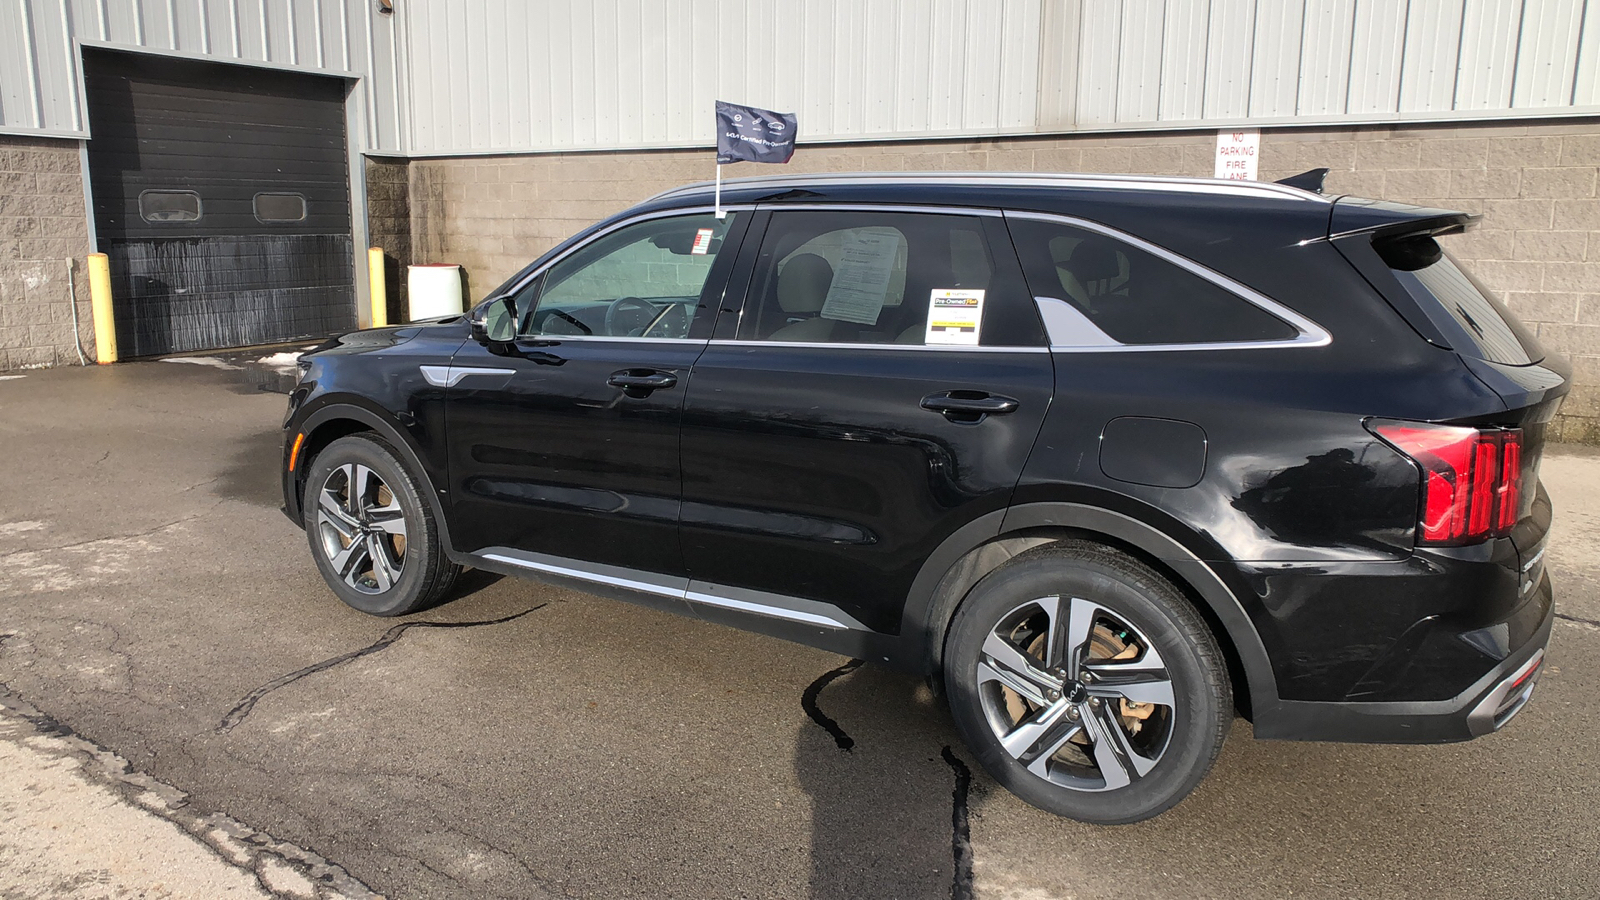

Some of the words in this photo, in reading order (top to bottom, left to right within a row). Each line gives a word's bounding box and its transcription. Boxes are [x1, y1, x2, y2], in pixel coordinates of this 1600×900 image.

[740, 135, 762, 145] Certified
[1232, 132, 1244, 142] NO
[1220, 145, 1254, 156] PARKING
[1226, 160, 1247, 169] FIRE
